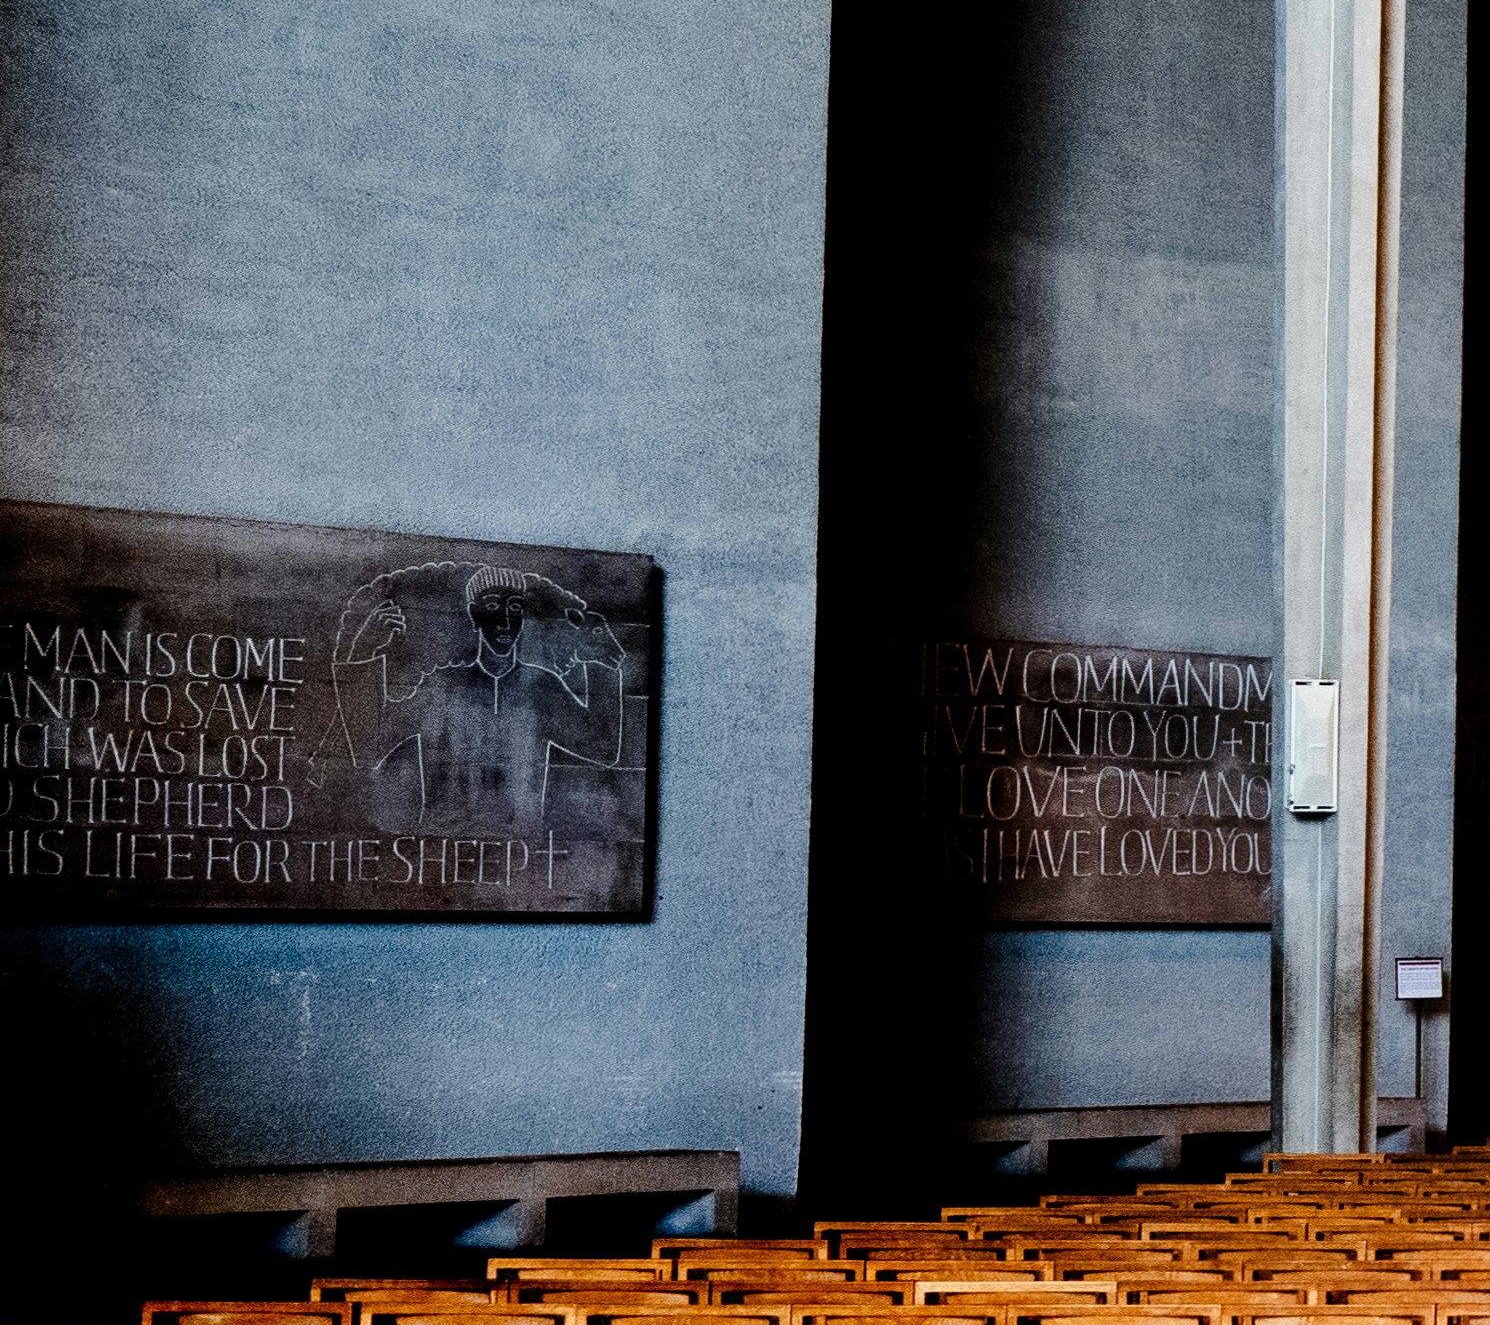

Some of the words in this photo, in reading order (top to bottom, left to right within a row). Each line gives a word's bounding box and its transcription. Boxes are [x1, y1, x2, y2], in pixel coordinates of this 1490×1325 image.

[23, 621, 132, 674] MAN
[145, 632, 178, 677] IS
[185, 632, 306, 684] COME
[111, 679, 174, 725] TO
[179, 681, 297, 732] SAVE
[1016, 705, 1136, 759] UNTO
[1143, 709, 1220, 763] YOU
[86, 725, 188, 774] WAS
[197, 731, 297, 783] LOST
[27, 773, 295, 832] SHEPHERD
[959, 764, 1088, 821] LOVE
[1095, 765, 1182, 819] ONE
[82, 829, 196, 881] LIFE
[205, 836, 293, 884] FOR
[301, 839, 381, 883] THE
[391, 834, 530, 889] SHEEP
[997, 826, 1092, 881] HAVE
[1100, 826, 1214, 877] LOVED
